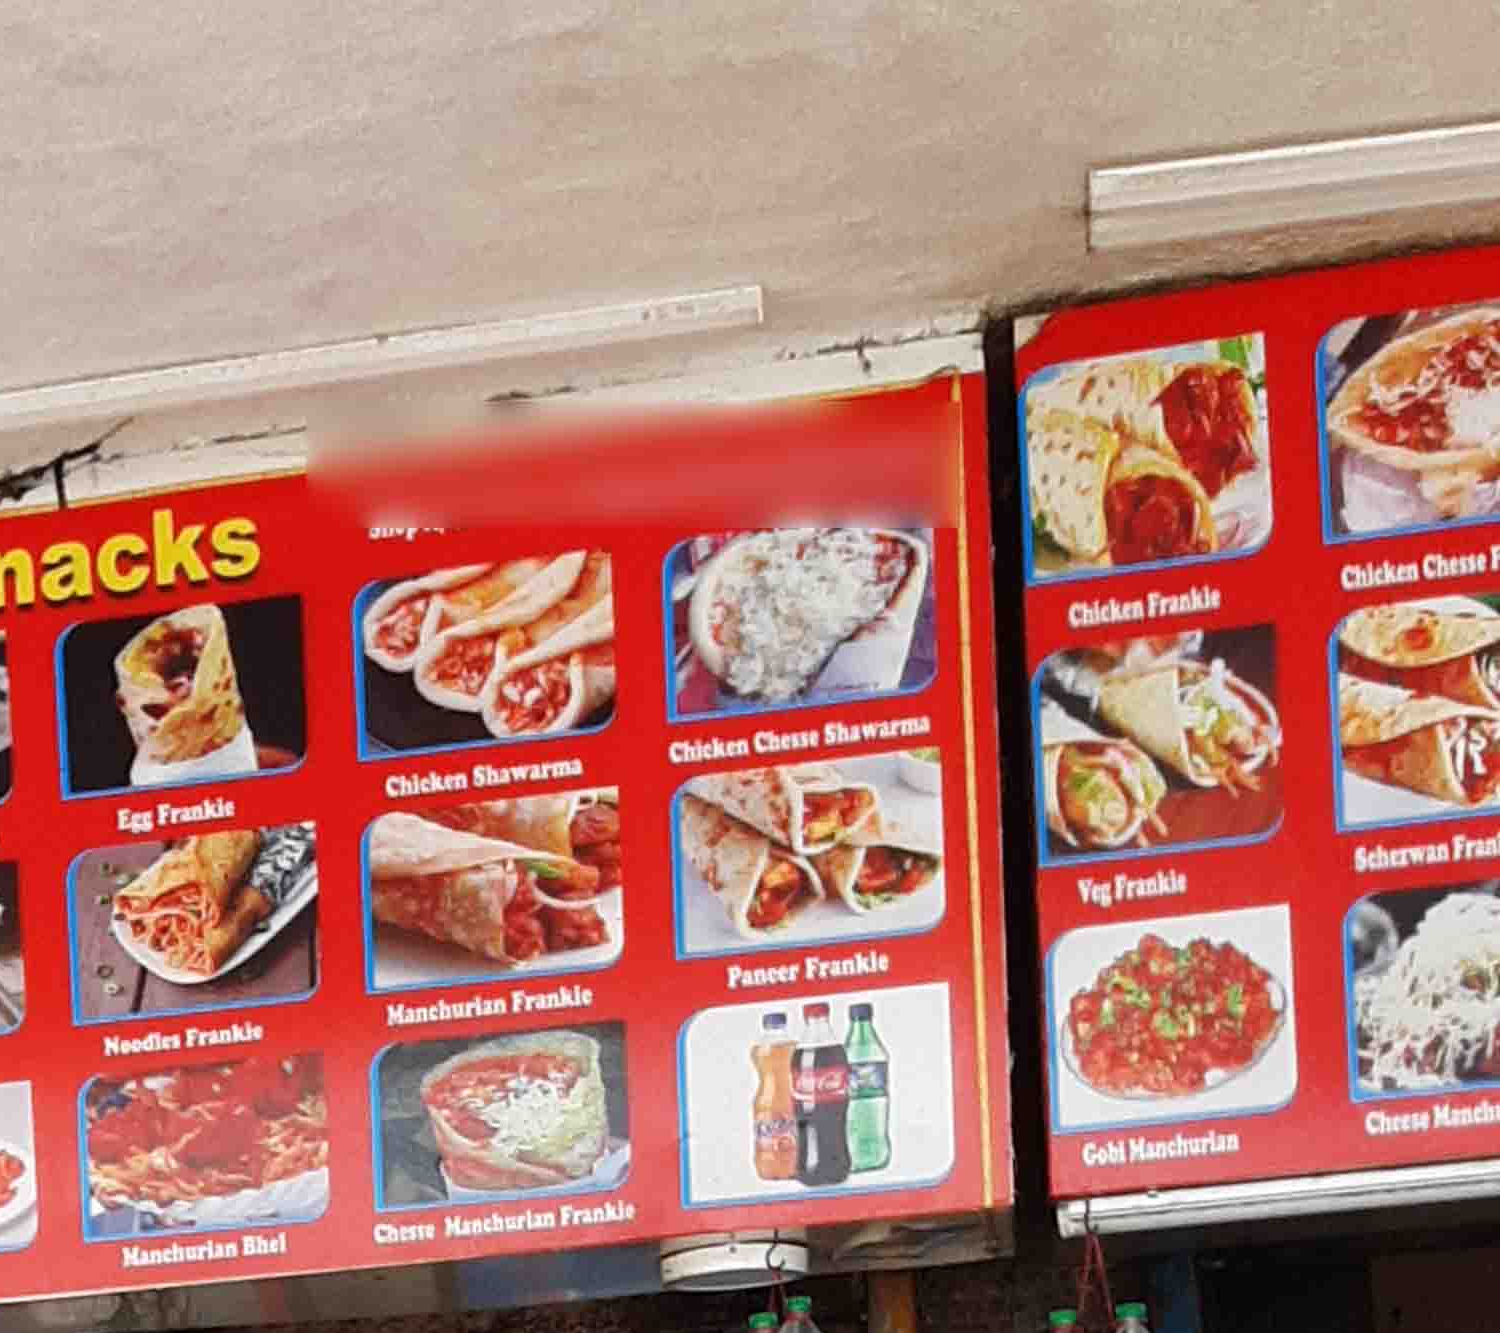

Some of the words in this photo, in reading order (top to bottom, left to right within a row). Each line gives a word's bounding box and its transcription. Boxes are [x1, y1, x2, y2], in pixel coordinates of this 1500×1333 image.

[1341, 560, 1419, 591] Chicken
[1068, 601, 1143, 628] Chicken
[1147, 587, 1220, 612] Frankie
[670, 739, 748, 764] Chicken
[824, 714, 930, 746] Shawarma
[386, 772, 468, 798] Chicken
[473, 757, 583, 786] Shawarma
[117, 808, 153, 832] Egg
[158, 797, 235, 823] Frankie
[1078, 879, 1112, 907] Veg
[1114, 869, 1187, 896] Frankie
[728, 964, 798, 989] Paneer
[804, 951, 889, 979] Frankie
[387, 999, 506, 1025] Manchurian
[511, 986, 592, 1012] Frankie
[104, 1033, 181, 1057] Noodles
[185, 1022, 263, 1048] Frankie
[1082, 1141, 1126, 1168] Gobi
[1128, 1131, 1239, 1163] Manchurian
[444, 1211, 555, 1238] Manchurian
[561, 1202, 635, 1227] Frankie
[122, 1241, 237, 1268] Manchurian
[242, 1232, 286, 1256] Bhel
